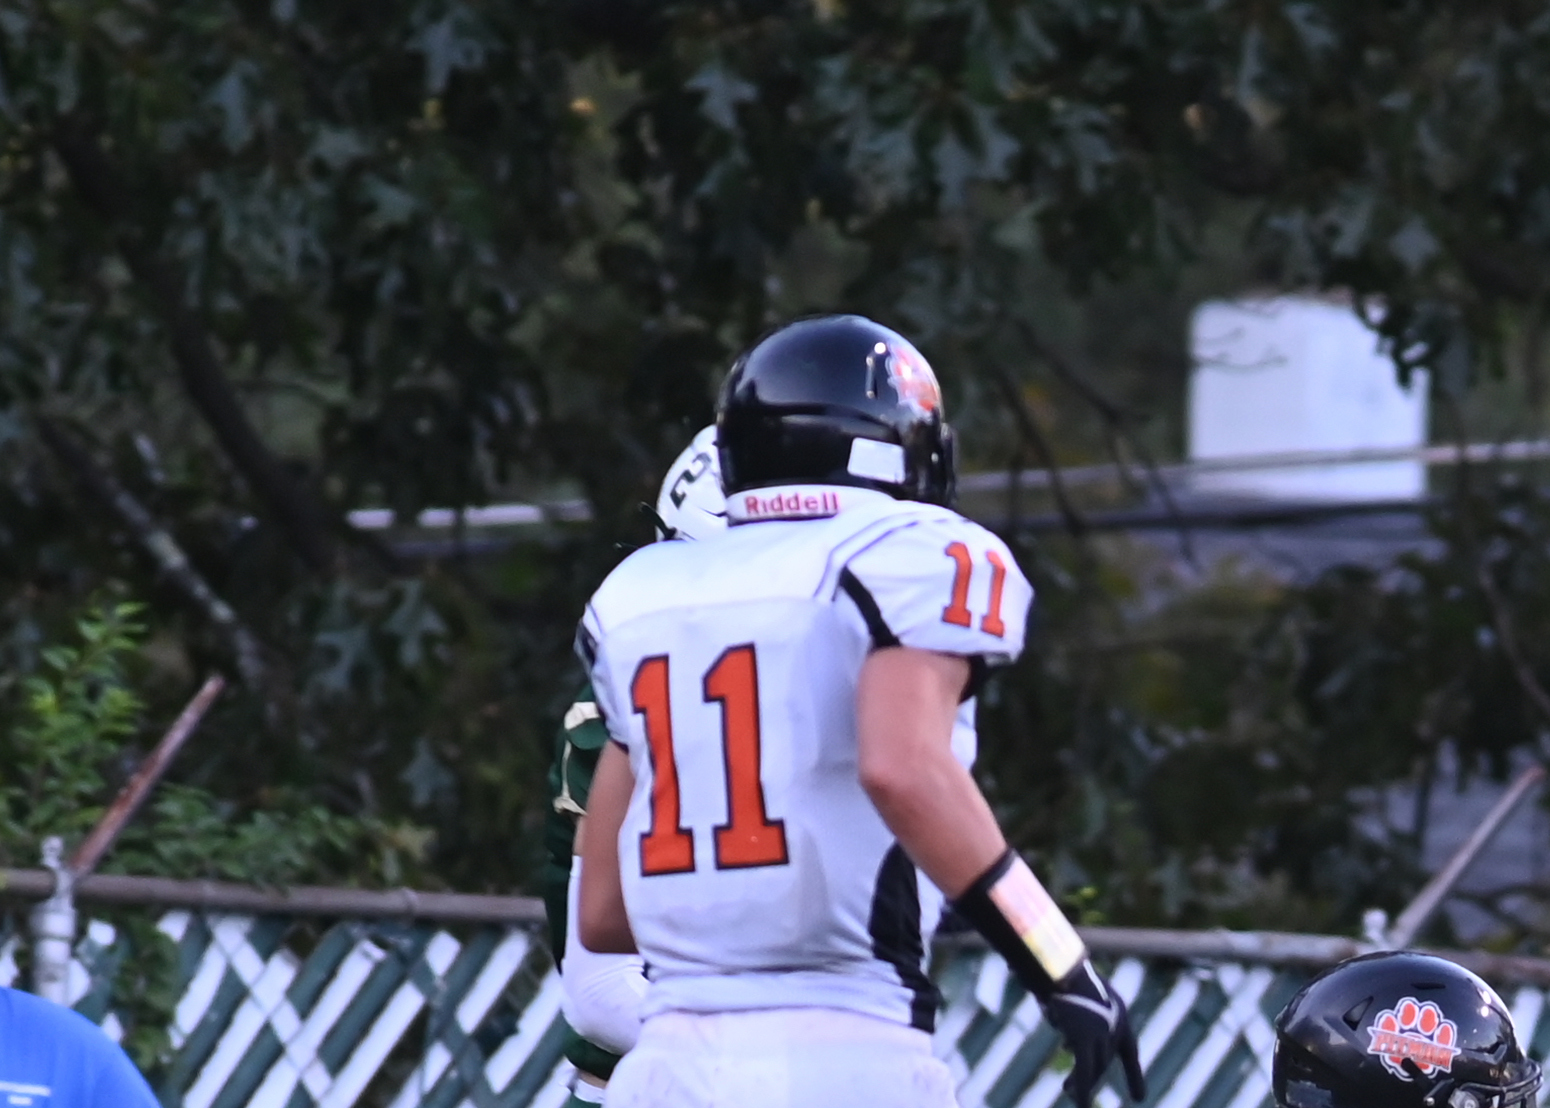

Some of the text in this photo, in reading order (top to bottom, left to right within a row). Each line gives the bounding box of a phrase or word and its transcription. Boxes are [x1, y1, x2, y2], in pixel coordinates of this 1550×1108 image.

[744, 492, 839, 515] Riddell
[940, 541, 1007, 638] 11
[630, 642, 789, 877] 11
